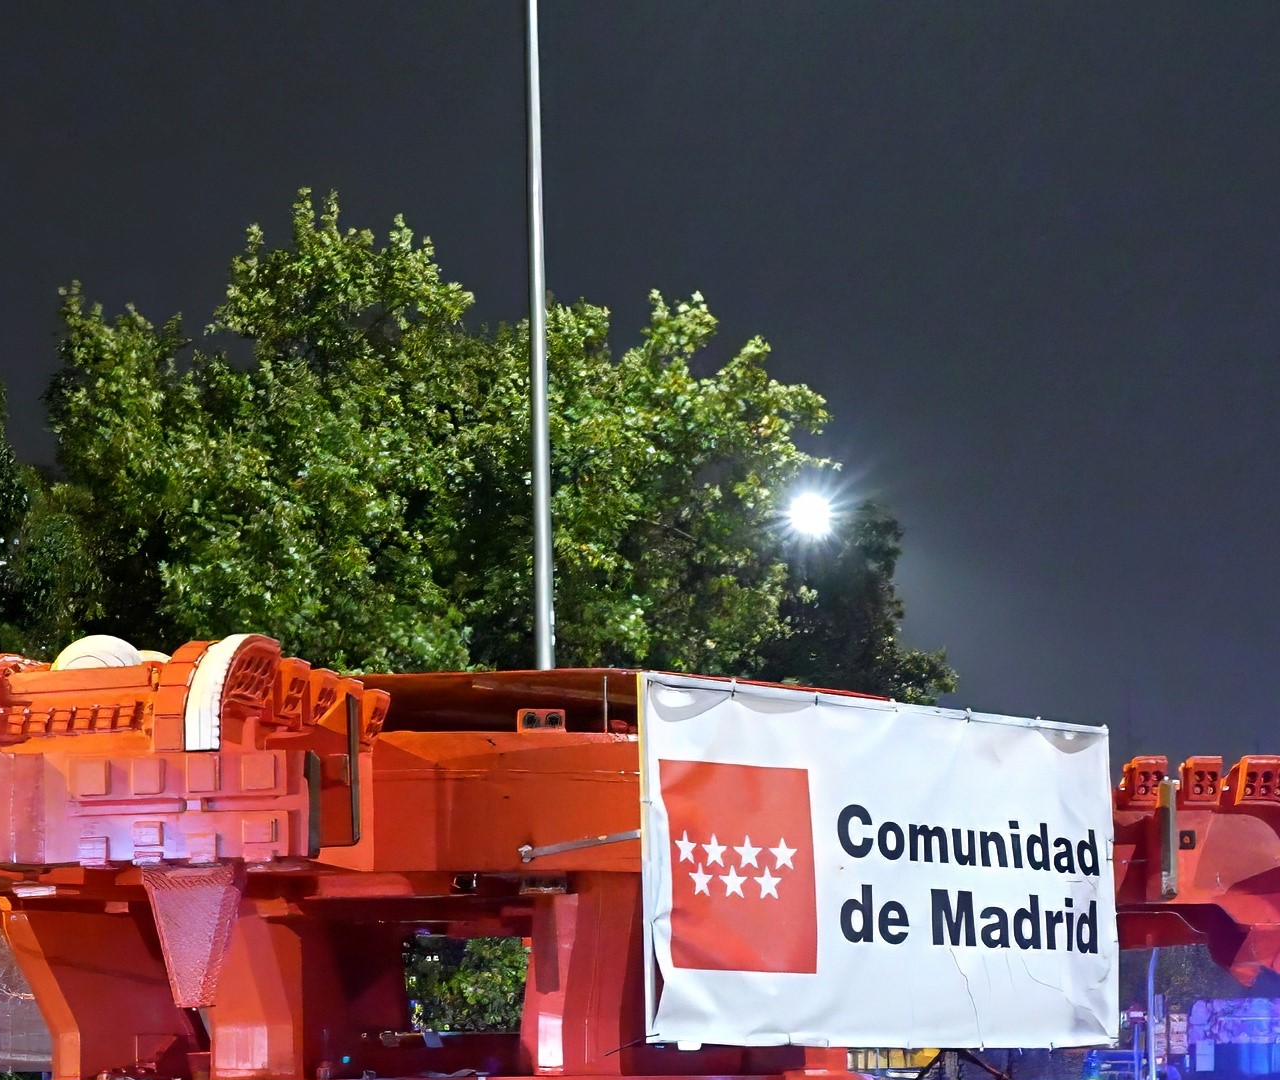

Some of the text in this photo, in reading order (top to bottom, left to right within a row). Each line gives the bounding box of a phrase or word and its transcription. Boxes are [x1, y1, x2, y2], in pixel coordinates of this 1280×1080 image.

[836, 803, 1100, 877] Comunidad
[839, 884, 1100, 954] de Madrid
